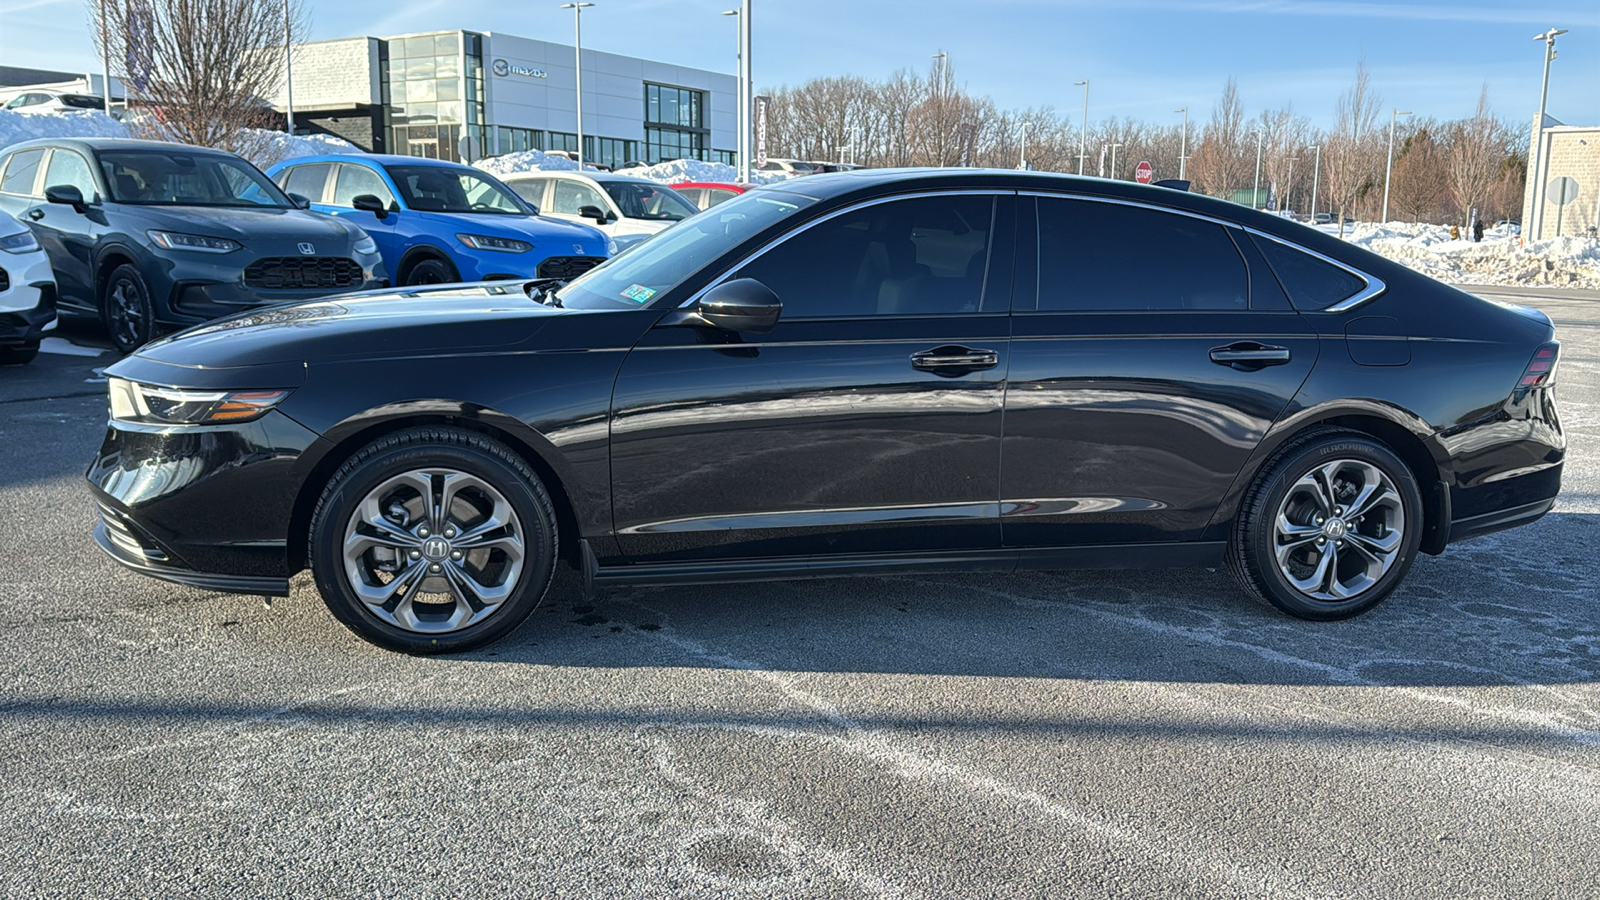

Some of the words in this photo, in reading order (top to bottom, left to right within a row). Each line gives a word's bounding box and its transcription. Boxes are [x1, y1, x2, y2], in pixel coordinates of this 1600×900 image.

[511, 65, 547, 79] mazda
[1137, 169, 1152, 179] STOP
[1320, 443, 1375, 455] BLACKHAWK
